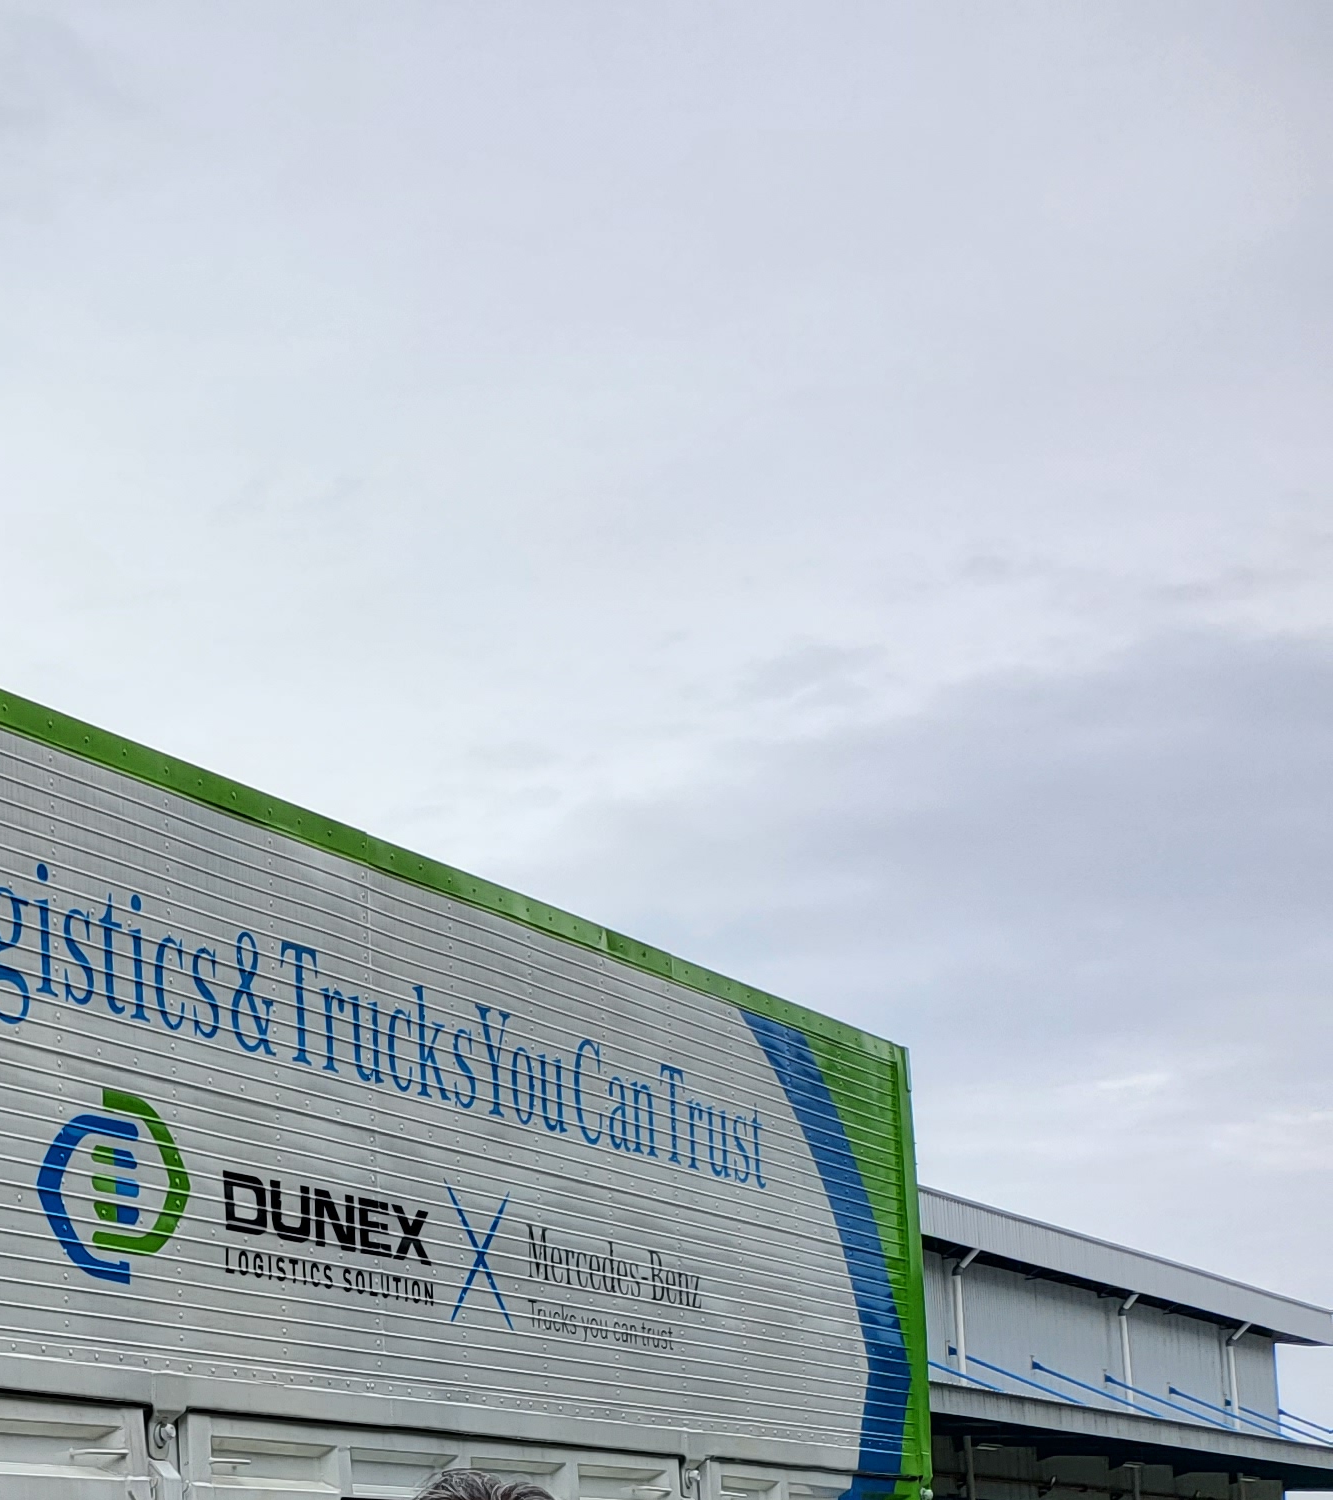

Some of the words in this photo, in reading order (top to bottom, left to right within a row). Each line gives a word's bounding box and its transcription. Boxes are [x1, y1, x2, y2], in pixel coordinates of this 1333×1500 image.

[223, 1169, 432, 1266] DUNEX
[225, 1247, 333, 1289] LOGISTICS
[343, 1268, 434, 1306] SOLUTION
[526, 1223, 702, 1309] Mercedes-Benz
[527, 1299, 577, 1335] Trucks
[581, 1315, 608, 1342] you
[613, 1319, 637, 1344] can
[641, 1322, 674, 1350] trust
